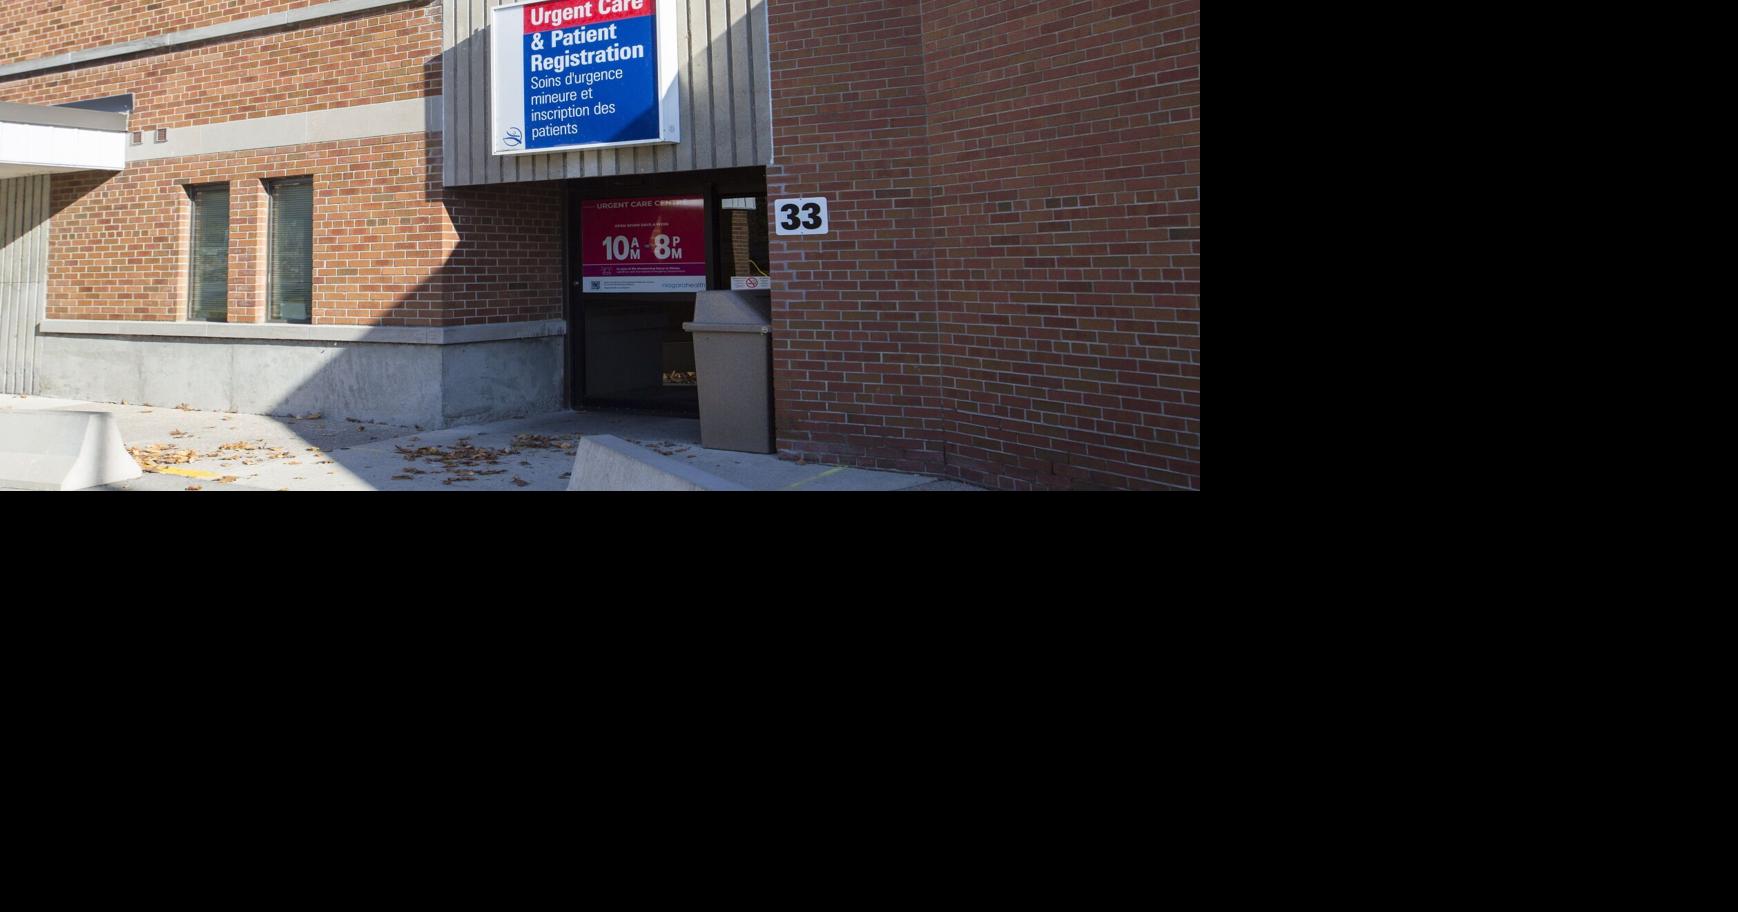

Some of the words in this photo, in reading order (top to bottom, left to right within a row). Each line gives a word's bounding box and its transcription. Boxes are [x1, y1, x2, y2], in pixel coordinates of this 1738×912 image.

[531, 2, 595, 26] Urgent
[598, 0, 643, 15] Care
[531, 33, 544, 51] &
[551, 24, 617, 47] Patient
[531, 43, 644, 73] Registration
[531, 74, 562, 90] Soins
[565, 68, 623, 86] d'urgence
[531, 90, 577, 105] mineure
[581, 88, 593, 100] et
[531, 103, 590, 123] inscription
[594, 102, 616, 116] des
[531, 124, 578, 141] patients
[596, 201, 630, 209] URGENT
[630, 200, 653, 208] CARE
[780, 202, 823, 231] 33
[602, 234, 630, 261] 10
[654, 233, 671, 260] 8
